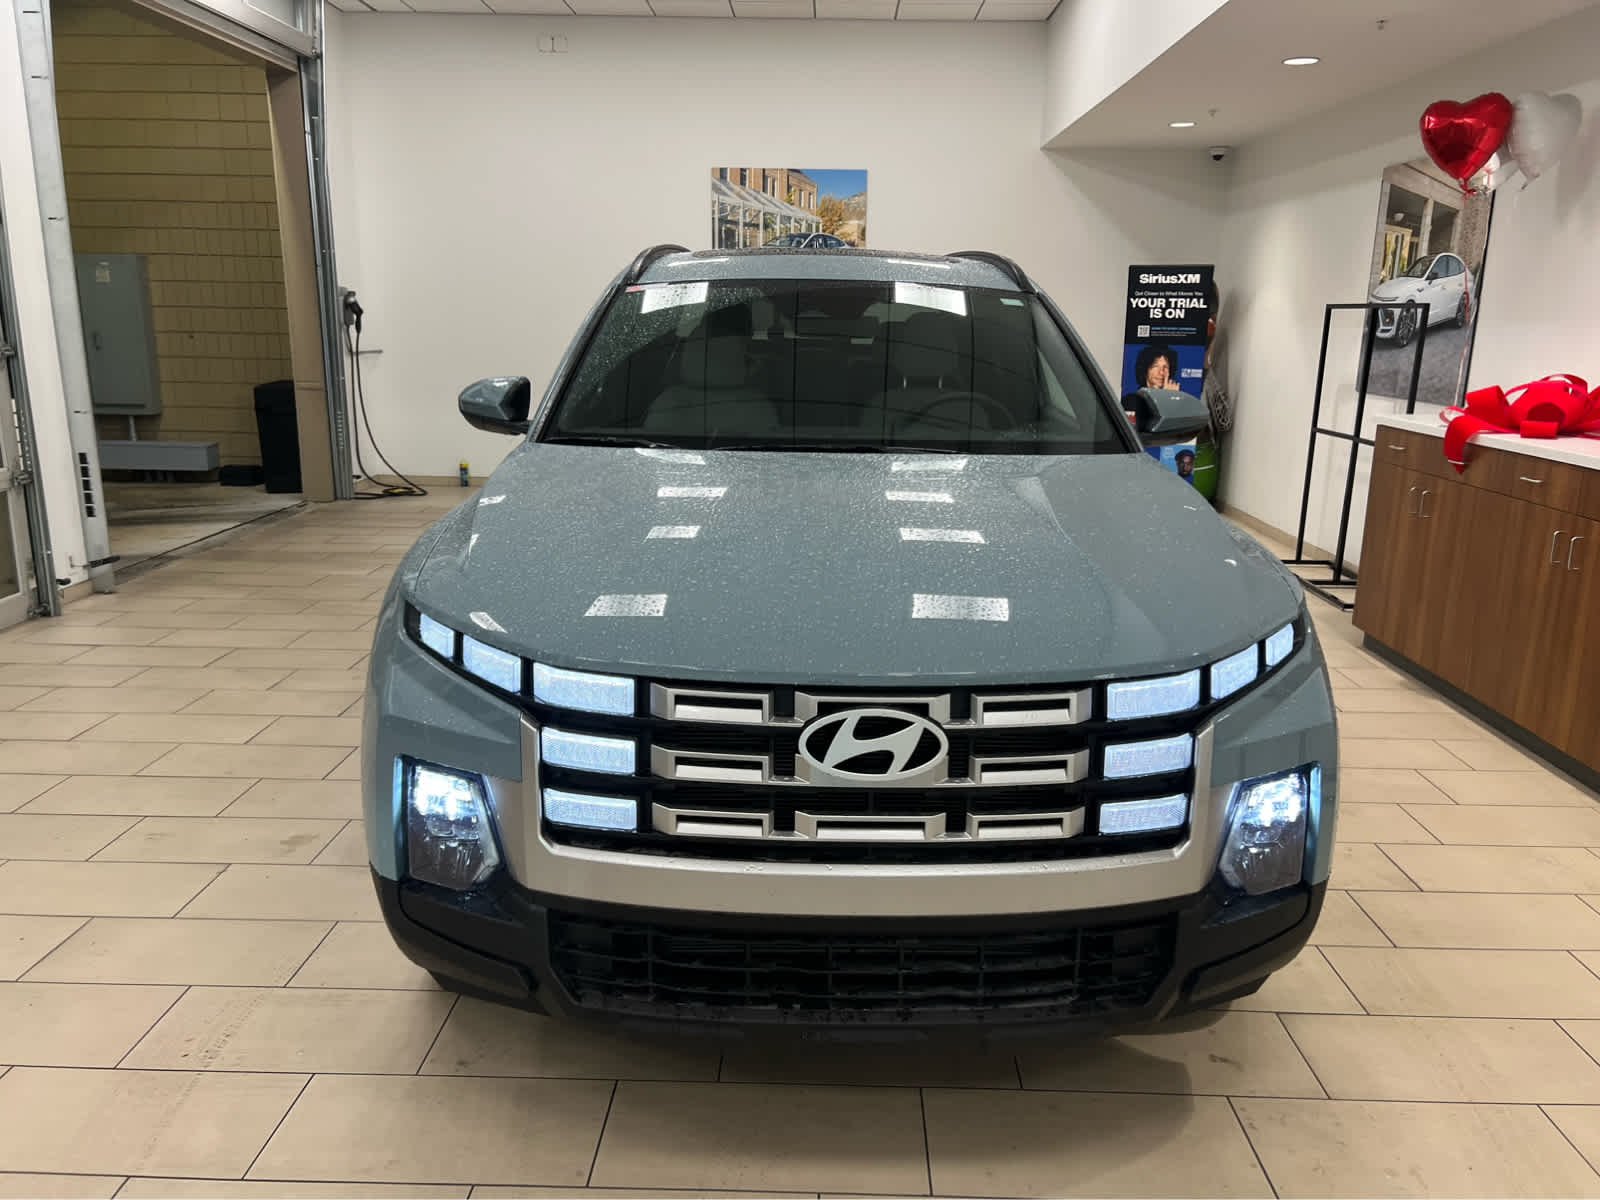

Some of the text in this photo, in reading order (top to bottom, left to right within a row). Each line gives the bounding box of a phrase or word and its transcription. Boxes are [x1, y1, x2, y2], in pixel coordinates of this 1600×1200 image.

[1139, 273, 1201, 284] SiriusXM
[1130, 297, 1207, 308] YOUR TRIAL
[1149, 308, 1185, 319] IS ON
